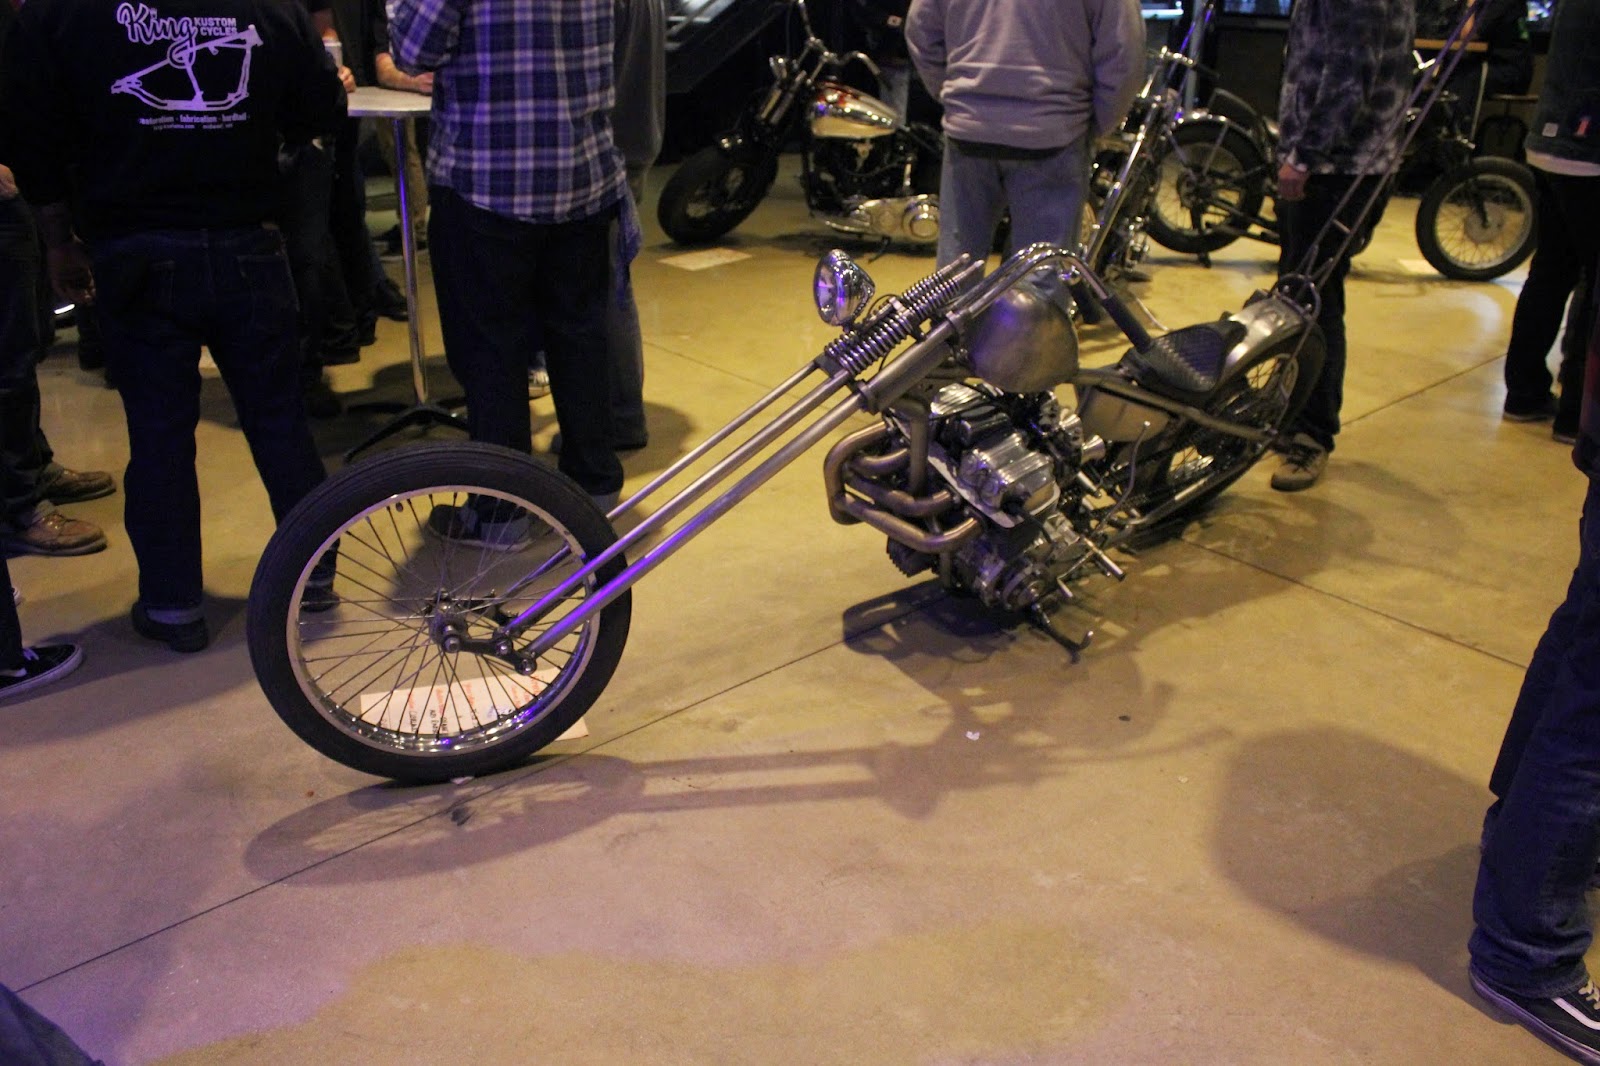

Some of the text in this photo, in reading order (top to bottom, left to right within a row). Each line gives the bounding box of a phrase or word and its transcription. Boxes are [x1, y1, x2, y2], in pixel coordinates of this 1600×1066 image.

[194, 17, 236, 27] KUSTOM
[117, 2, 198, 68] King
[200, 27, 237, 36] CYCLES
